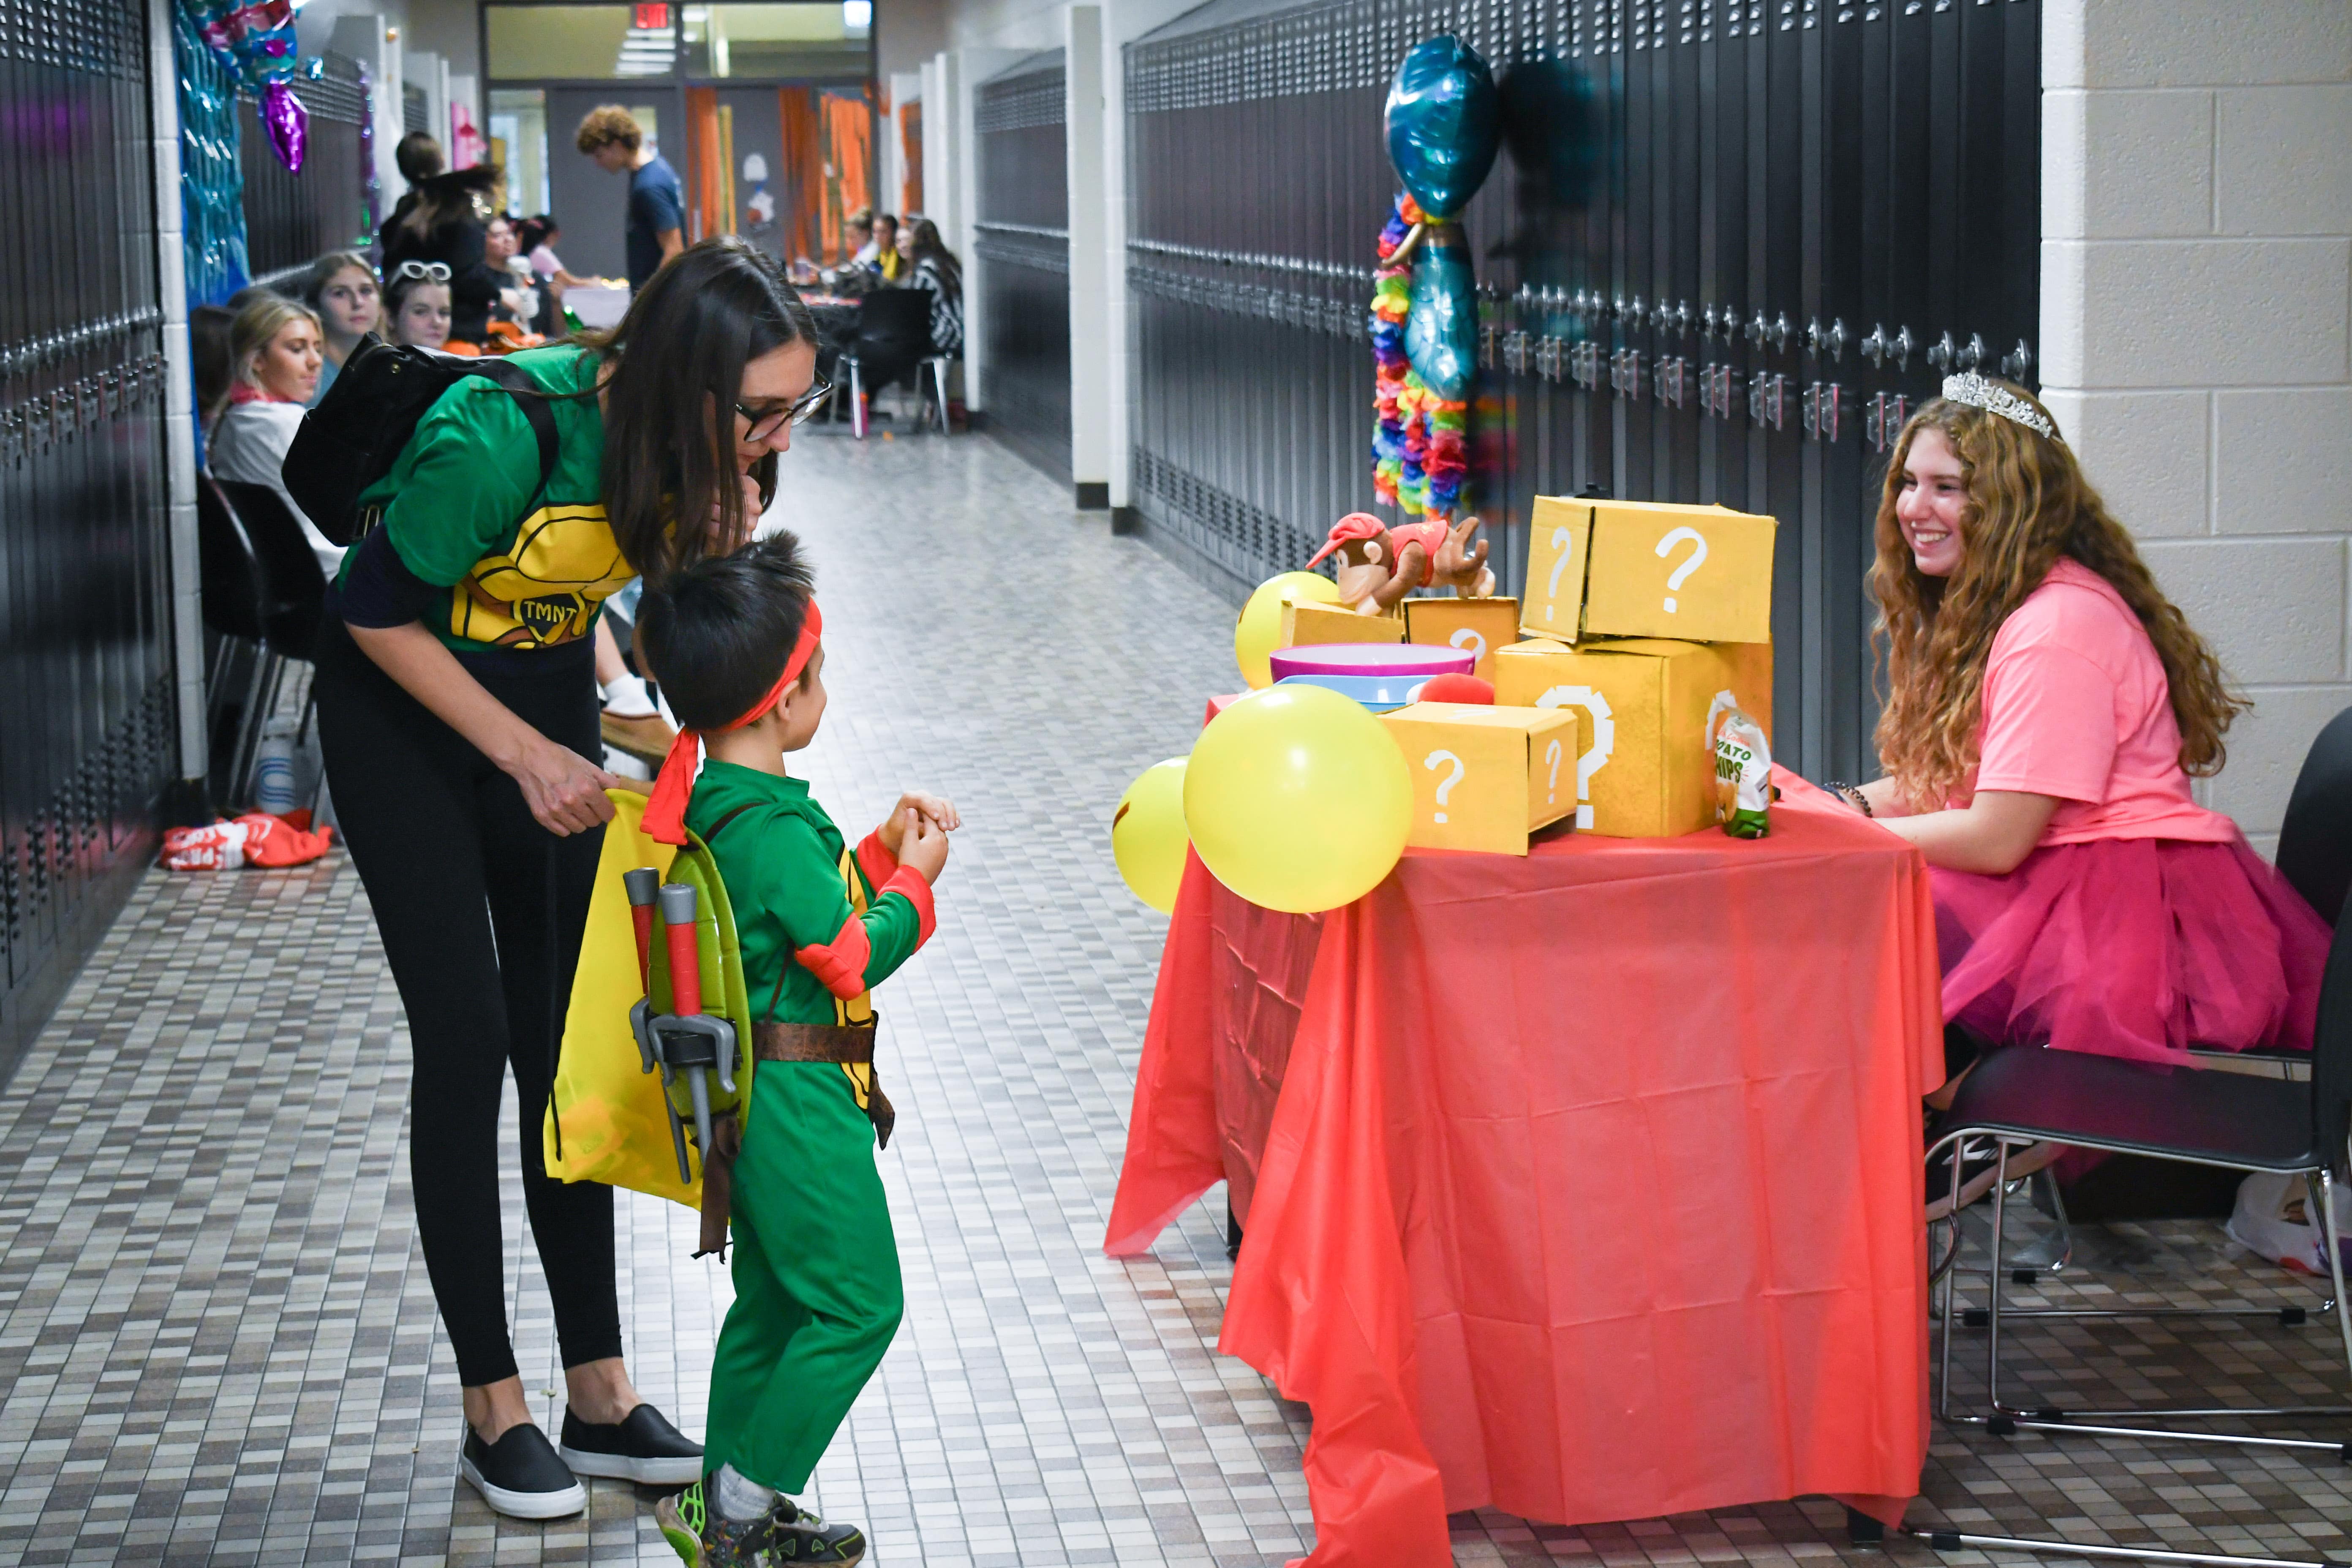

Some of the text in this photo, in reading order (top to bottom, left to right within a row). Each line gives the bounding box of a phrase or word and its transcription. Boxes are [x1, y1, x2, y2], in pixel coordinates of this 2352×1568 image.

[1655, 526, 1708, 613] ?
[523, 601, 577, 623] TMNT
[1424, 749, 1465, 823] ?
